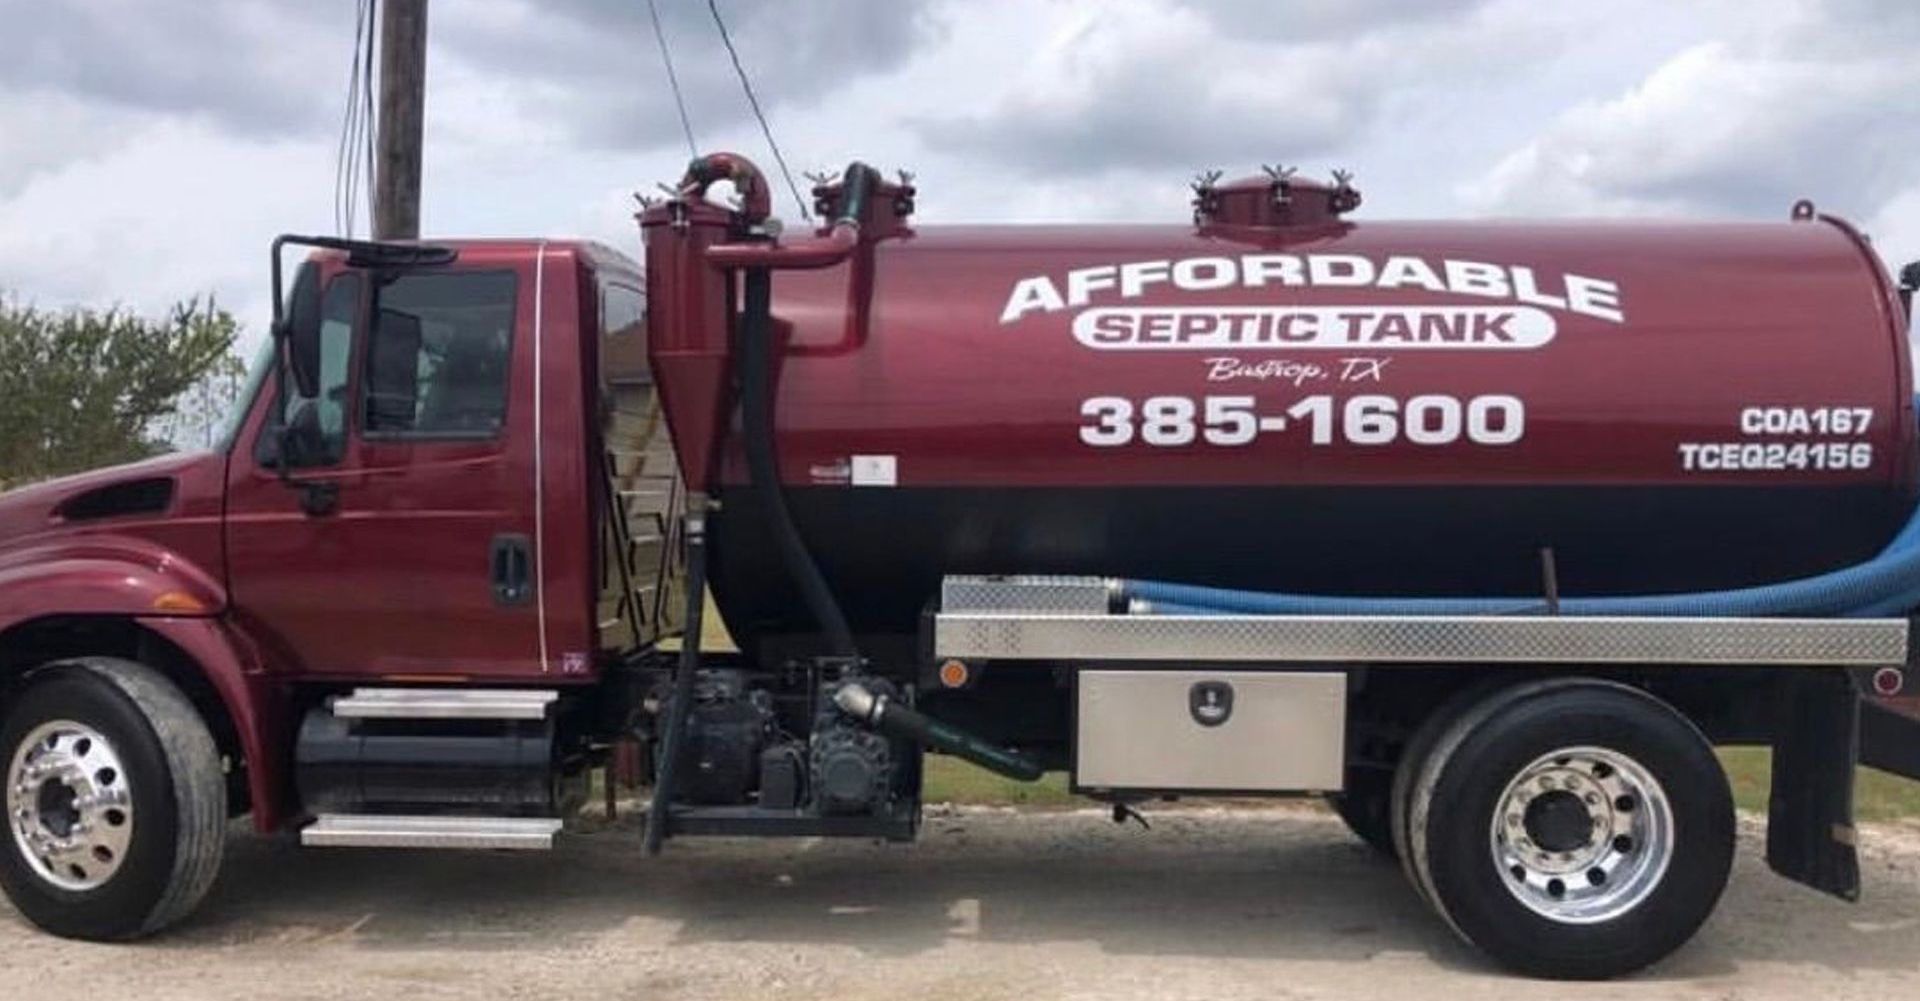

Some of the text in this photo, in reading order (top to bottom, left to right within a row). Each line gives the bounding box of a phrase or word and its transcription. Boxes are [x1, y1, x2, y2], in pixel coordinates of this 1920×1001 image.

[1000, 253, 1624, 324] AFFORDABLE
[1092, 312, 1516, 342] SEPTIC TANK
[1340, 357, 1390, 382] TX
[1079, 396, 1525, 446] 385-1600
[1740, 407, 1873, 434] COA167
[1679, 443, 1873, 470] TCEQ24156
